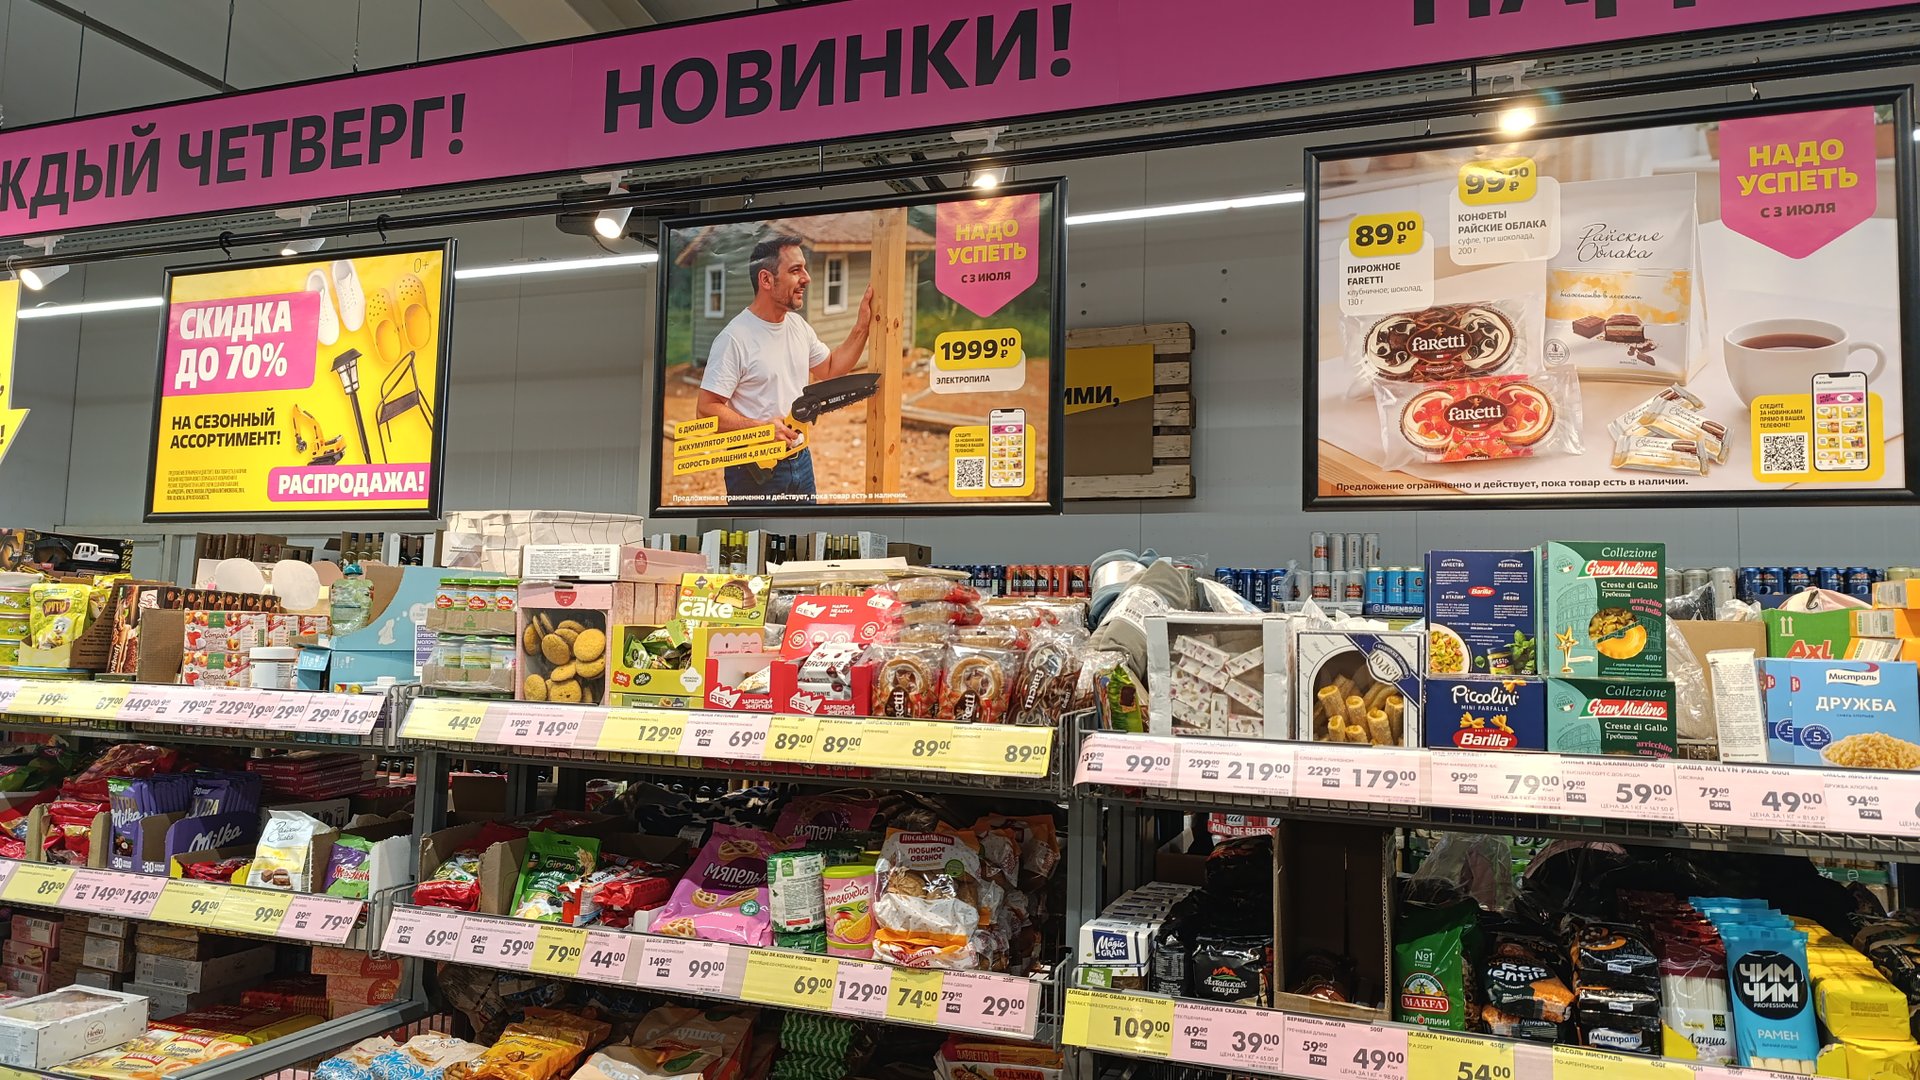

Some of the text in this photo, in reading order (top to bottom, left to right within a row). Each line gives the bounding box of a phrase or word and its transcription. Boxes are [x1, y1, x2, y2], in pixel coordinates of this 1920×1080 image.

[604, 3, 1072, 133] НОВИНКИ!
[178, 93, 466, 186] ЧЕТВЕРГ!
[1748, 138, 1845, 169] НАДО
[1736, 166, 1859, 199] УСПЕТЬ
[1458, 211, 1507, 222] КОНФЕТЫ
[1760, 201, 1836, 218] С 3 ИЮЛЯ
[955, 219, 1019, 242] НАДО
[1458, 219, 1547, 235] РАЙСКИЕ ОБЛАКА
[1458, 232, 1534, 246] суфле, три шоколада,
[1577, 223, 1665, 251] Райские
[947, 243, 1027, 265] УСПЕТЬ
[1458, 246, 1472, 255] 200
[1577, 242, 1654, 263] Облака
[1347, 262, 1401, 274] ПИРОЖНОЕ
[961, 272, 1011, 283] С 3 ИЮЛЯ
[1347, 276, 1384, 286] FARETTI
[1347, 298, 1358, 306] 130
[179, 300, 292, 343] СКИДКА
[174, 342, 288, 389] ДО 70%
[936, 375, 990, 385] ЭЛЕКТРОПИЛА
[172, 407, 275, 430] НА СЕЗОННЫЙ
[1767, 408, 1803, 416] НОВИНКАМИ
[678, 421, 714, 435] 6 ДЮЙМОВ
[170, 431, 281, 449] АССОРТИМЕНТ!
[678, 429, 771, 452] АККУМУЛЯТОР 1500 МАЧ 20В
[677, 446, 782, 471] СКОРОСТЬ ВРАЩЕНИЯ 4,8 М/СЕК
[278, 471, 425, 497] РАСПРОДАЖА!
[1336, 482, 1404, 492] Предложение
[1406, 481, 1472, 491] ограниченно
[1483, 479, 1539, 490] действует,
[1541, 479, 1567, 487] пока
[1569, 478, 1600, 489] товар
[1602, 478, 1626, 487] есть
[1638, 476, 1688, 486] наличии.
[672, 493, 720, 503] Предложение
[720, 492, 765, 502] ограниченно
[772, 492, 809, 502] действует,
[810, 492, 828, 501] пока
[829, 492, 850, 501] товар
[874, 491, 908, 499] наличии.
[1601, 546, 1657, 558] Collezione
[1585, 560, 1656, 577] Gran Mulino
[1601, 581, 1658, 589] Creste di Gallo
[678, 600, 733, 619] cake
[1382, 604, 1423, 614] LÖWENBRÄU
[804, 660, 844, 668] BROWNIE
[1829, 672, 1877, 682] Мистраль
[1451, 685, 1519, 705] Piccolini
[1605, 684, 1667, 698] Collezione
[710, 694, 732, 708] REX
[790, 700, 814, 713] REX
[1816, 696, 1897, 712] ДРУЖБА
[1460, 731, 1510, 747] Barilla
[111, 808, 144, 828] Milka
[1212, 823, 1230, 834] KING
[1233, 825, 1244, 835] OF
[188, 823, 242, 853] Milka
[908, 846, 945, 854] ЛЮБИМОЕ
[910, 854, 942, 862] ОВСЯНОЕ
[1096, 935, 1127, 953] Magic
[1101, 949, 1126, 957] GRAIN
[1739, 963, 1794, 983] ЧИМ
[1203, 976, 1248, 990] Алтайская
[1213, 985, 1239, 995] сказка
[1743, 983, 1798, 1003] ЧИМ
[1405, 997, 1445, 1009] MAKFA
[1591, 1031, 1640, 1044] Мистраль
[1758, 1029, 1799, 1041] РАМЕН
